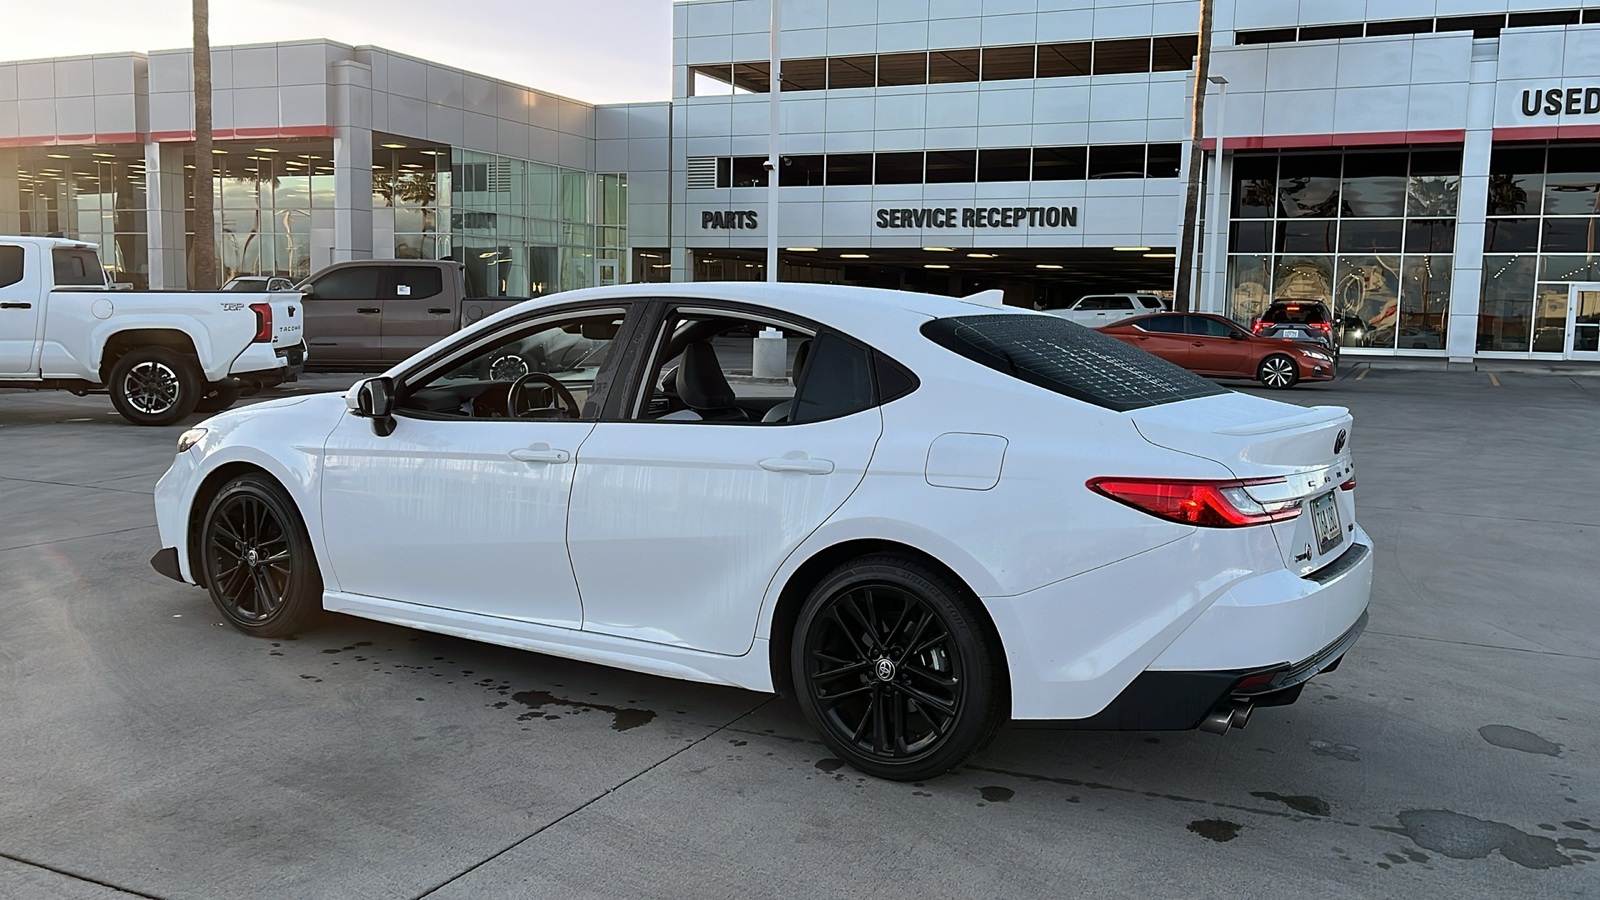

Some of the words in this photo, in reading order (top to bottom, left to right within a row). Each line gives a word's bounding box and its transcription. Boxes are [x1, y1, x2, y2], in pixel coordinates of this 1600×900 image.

[1522, 87, 1600, 116] USED
[701, 210, 758, 229] PARTS
[876, 208, 957, 228] SERVICE
[961, 206, 1078, 228] RECEPTION
[279, 325, 301, 333] TACOMA
